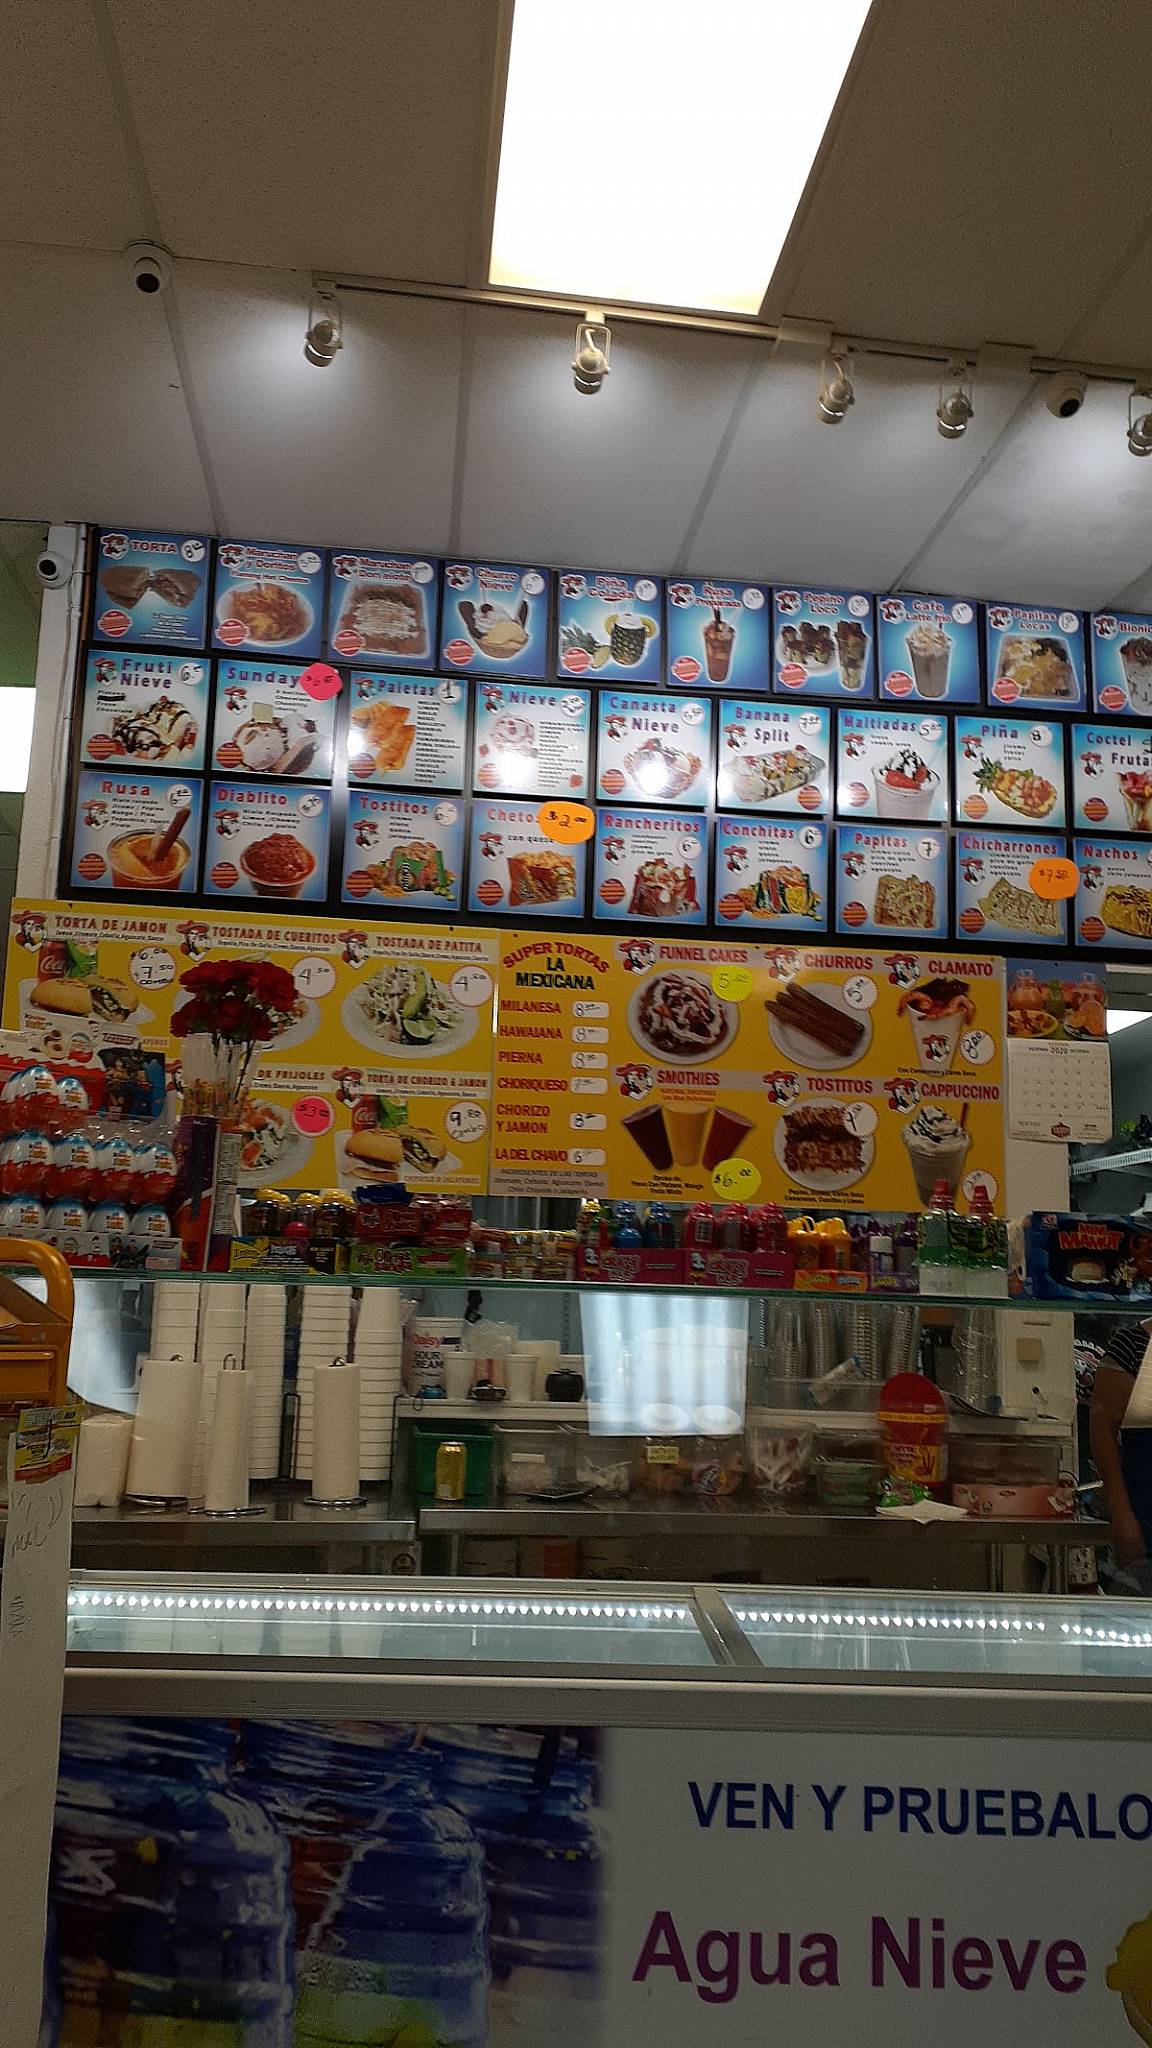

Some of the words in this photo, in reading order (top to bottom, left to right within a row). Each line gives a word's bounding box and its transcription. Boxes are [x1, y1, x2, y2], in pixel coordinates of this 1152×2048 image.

[131, 540, 178, 554] TORTA
[1012, 608, 1057, 621] Papitas
[121, 658, 173, 674] Fruti
[119, 673, 172, 688] Nieve
[378, 679, 435, 697] Paletas
[509, 693, 557, 706] Nieve
[610, 697, 676, 714] Canasta
[735, 707, 790, 723] Banana
[631, 717, 680, 733] Nieve
[981, 724, 1019, 739] Piña
[754, 728, 791, 743] Split
[1087, 732, 1132, 746] Coctel
[1111, 752, 1152, 766] Fruta
[101, 781, 151, 796] Rusa
[217, 788, 288, 805] Diablito
[359, 797, 429, 815] Tostitos
[603, 812, 701, 833] Rancheritos
[722, 822, 795, 839] Conchitas
[855, 832, 908, 849] Papitas
[962, 836, 1058, 855] Chicharrones
[1083, 844, 1138, 860] Nachos
[55, 916, 98, 929] TORTA
[100, 919, 118, 930] DE
[122, 921, 168, 934] JAMON
[212, 926, 264, 940] TOSTADA
[266, 929, 281, 940] DE
[284, 931, 337, 944] CUERITOS
[375, 936, 423, 949] TOSTADA
[428, 938, 442, 950] DE
[444, 939, 482, 952] PATITA
[502, 942, 553, 968] SUPER
[554, 942, 610, 974] TORTAS
[659, 946, 706, 961] FUNNEL
[709, 948, 748, 963] CAKES
[804, 954, 873, 969] CHURROS
[546, 957, 565, 972] LA
[928, 960, 993, 976] CLAMATO
[515, 973, 595, 990] MEXICANA
[500, 1000, 561, 1014] MILANESA
[499, 1025, 563, 1040] HAWAIANA
[498, 1051, 543, 1065] PIERNA
[257, 1069, 274, 1080] DE
[275, 1070, 326, 1080] FRIJOLES
[367, 1073, 394, 1085] TORTA
[396, 1074, 410, 1085] DE
[411, 1075, 449, 1086] CHORIZO
[458, 1077, 488, 1088] JAMON
[657, 1070, 720, 1086] SMOTHIES
[497, 1077, 568, 1092] CHORIQUESO
[806, 1077, 873, 1093] TOSTITOS
[921, 1083, 1000, 1100] CAPPUCCINO
[496, 1104, 550, 1117] CHORIZO
[496, 1122, 504, 1132] Y
[505, 1123, 549, 1134] JAMON
[495, 1148, 508, 1160] LA
[510, 1149, 529, 1161] DEL
[532, 1149, 568, 1162] CHAVO
[414, 1351, 440, 1360] SOUR
[688, 1781, 794, 1830] VEN
[812, 1784, 847, 1831] Y
[863, 1785, 1152, 1842] PRUEBALO
[632, 1911, 840, 2004] Agua
[871, 1915, 1088, 1994] Nieve
